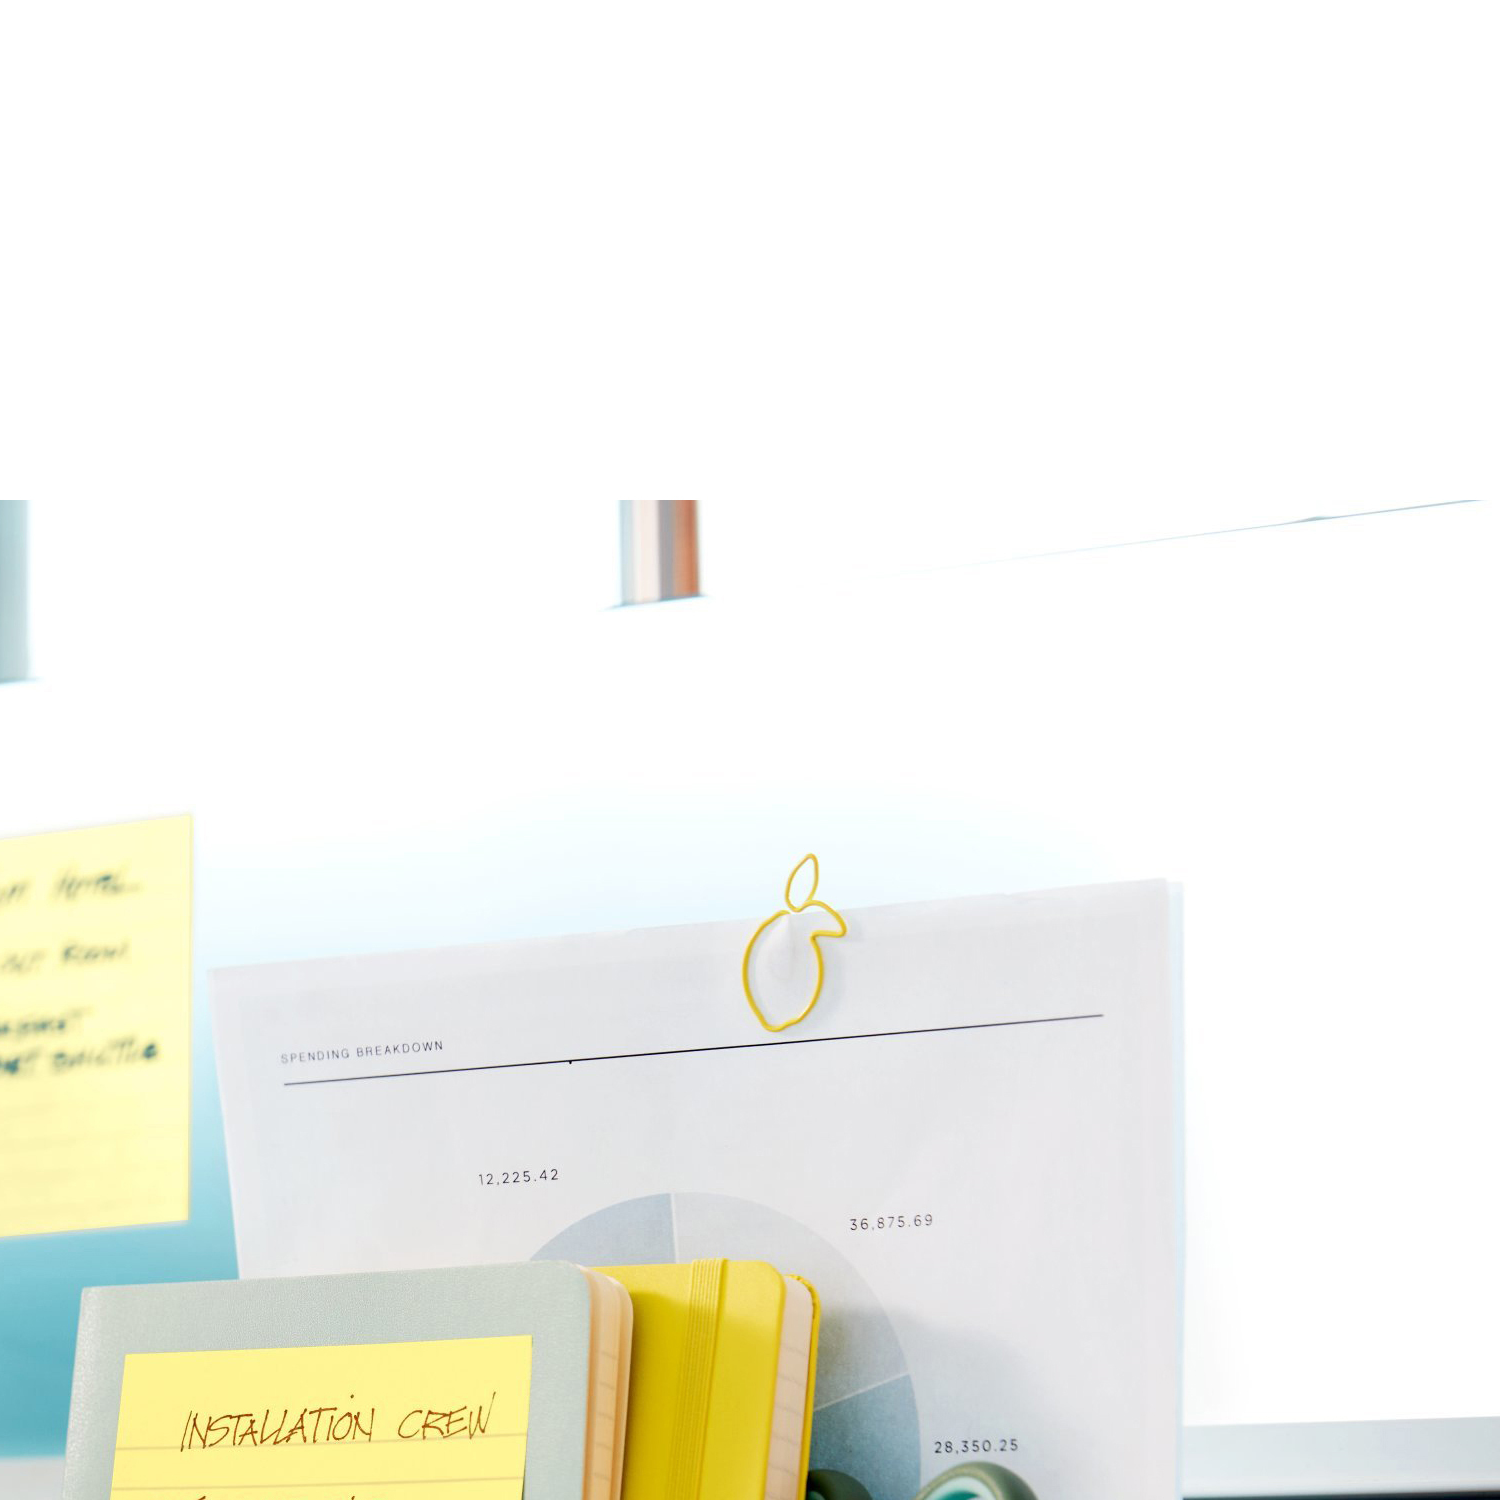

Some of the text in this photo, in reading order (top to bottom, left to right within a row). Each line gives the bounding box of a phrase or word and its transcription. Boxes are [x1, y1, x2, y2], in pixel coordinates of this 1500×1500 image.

[280, 1040, 445, 1065] SPENDING BREAKDOWN
[478, 1168, 560, 1186] 12,225.42
[849, 1213, 934, 1232] 36,875.69
[397, 1391, 497, 1441] CREW
[934, 1438, 1019, 1455] 28,350.25
